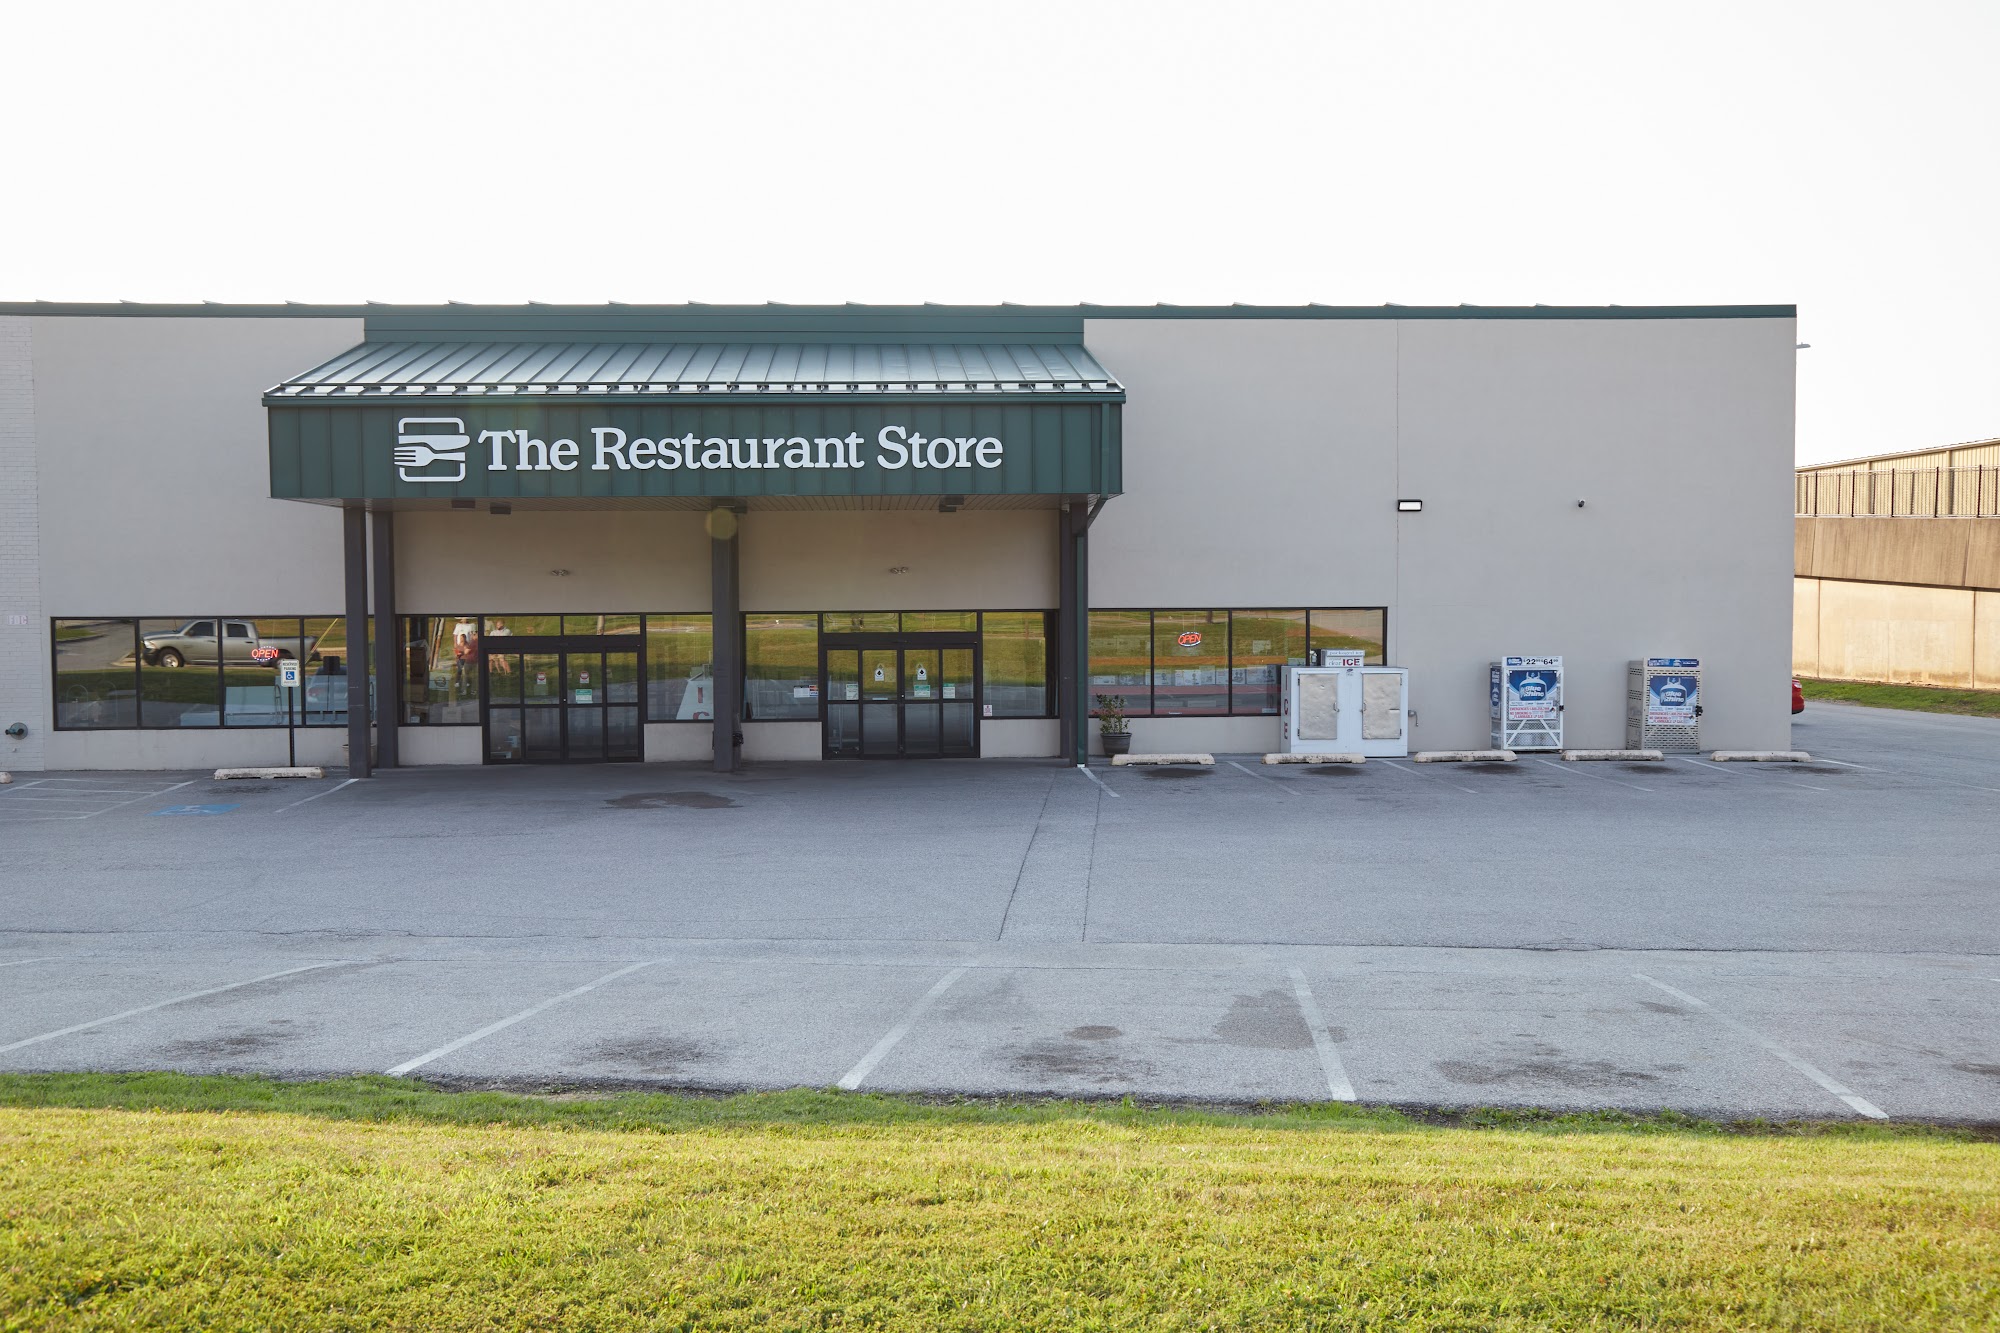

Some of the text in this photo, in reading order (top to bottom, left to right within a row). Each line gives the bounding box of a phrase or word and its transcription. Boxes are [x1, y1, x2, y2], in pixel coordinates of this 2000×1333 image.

[477, 425, 1004, 471] The Restaurant Store
[1177, 633, 1202, 645] OPEN
[251, 649, 279, 658] OPEN
[1342, 658, 1361, 666] ICE
